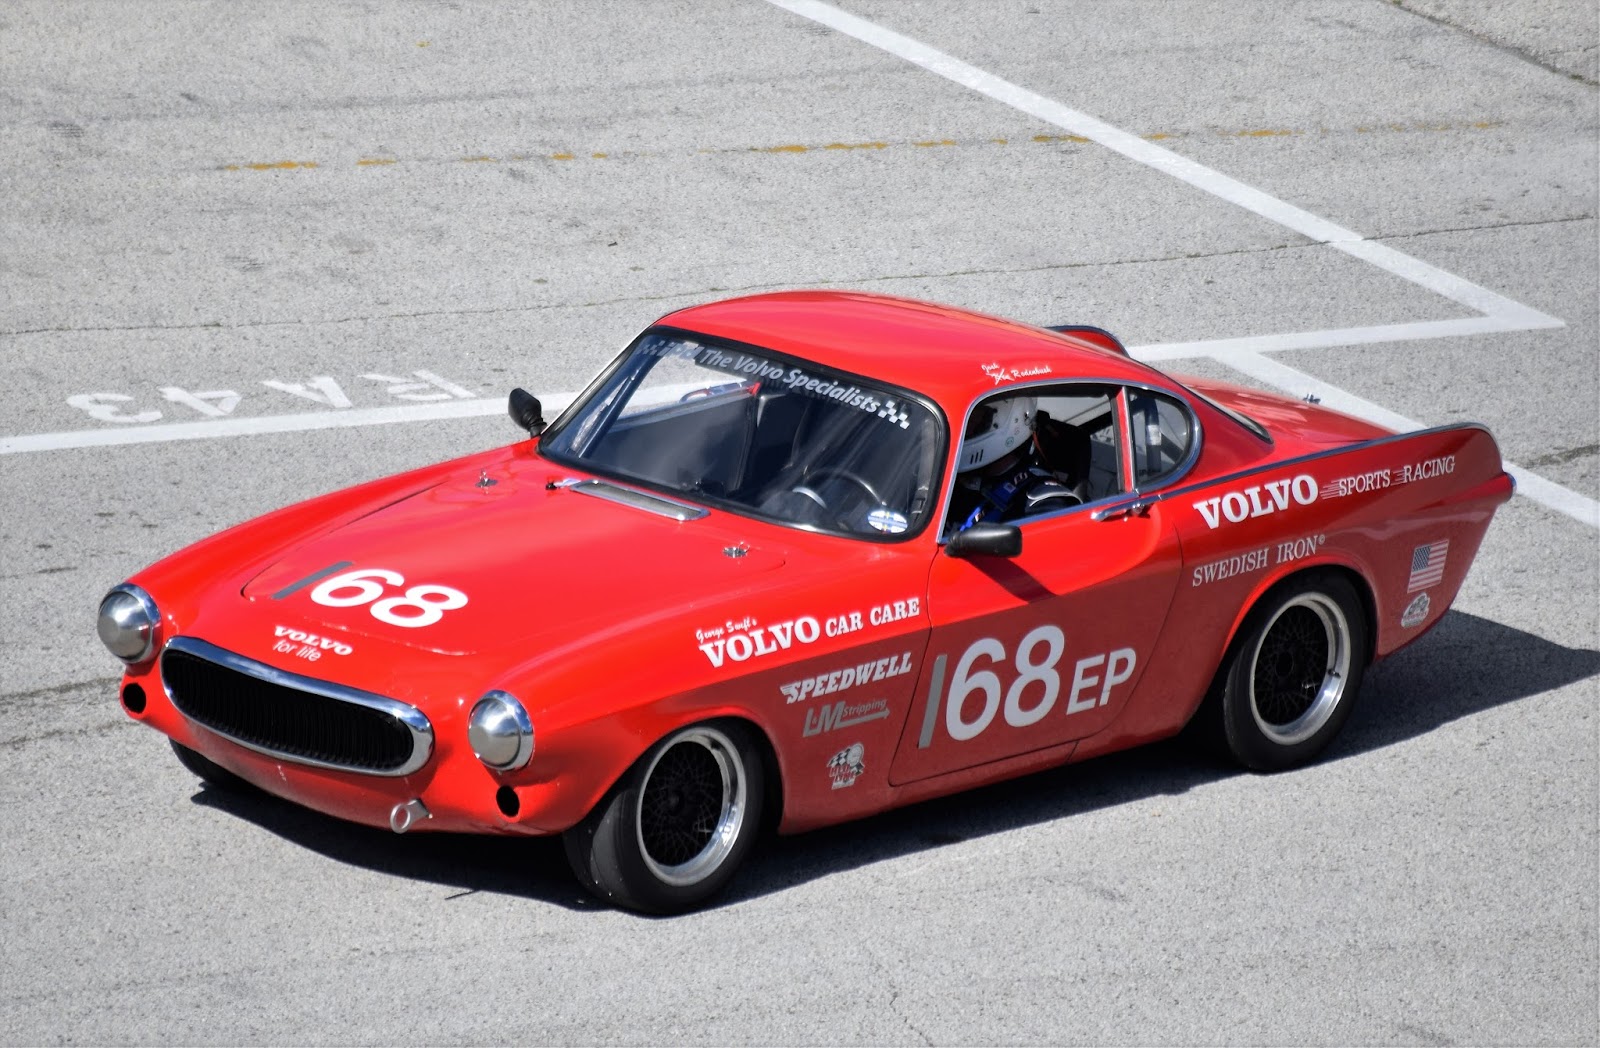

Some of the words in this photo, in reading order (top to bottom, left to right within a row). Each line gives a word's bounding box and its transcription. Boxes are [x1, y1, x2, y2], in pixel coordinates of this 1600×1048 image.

[700, 349, 733, 369] The
[733, 356, 784, 381] Volvo
[784, 369, 880, 414] Specialists
[1193, 474, 1319, 529] VOLVO
[1338, 469, 1391, 497] SPORTS
[1402, 455, 1456, 483] RACING
[1192, 548, 1269, 587] SWEDISH
[273, 640, 297, 654] for
[297, 646, 321, 662] life
[274, 625, 353, 656] VOLVO
[696, 628, 724, 644] George
[699, 616, 821, 668] VOLVO
[825, 612, 863, 637] CAR
[870, 598, 920, 626] CARE
[780, 652, 912, 704] SPEEDWELL
[1066, 648, 1137, 715] EP
[843, 699, 887, 718] Stripping
